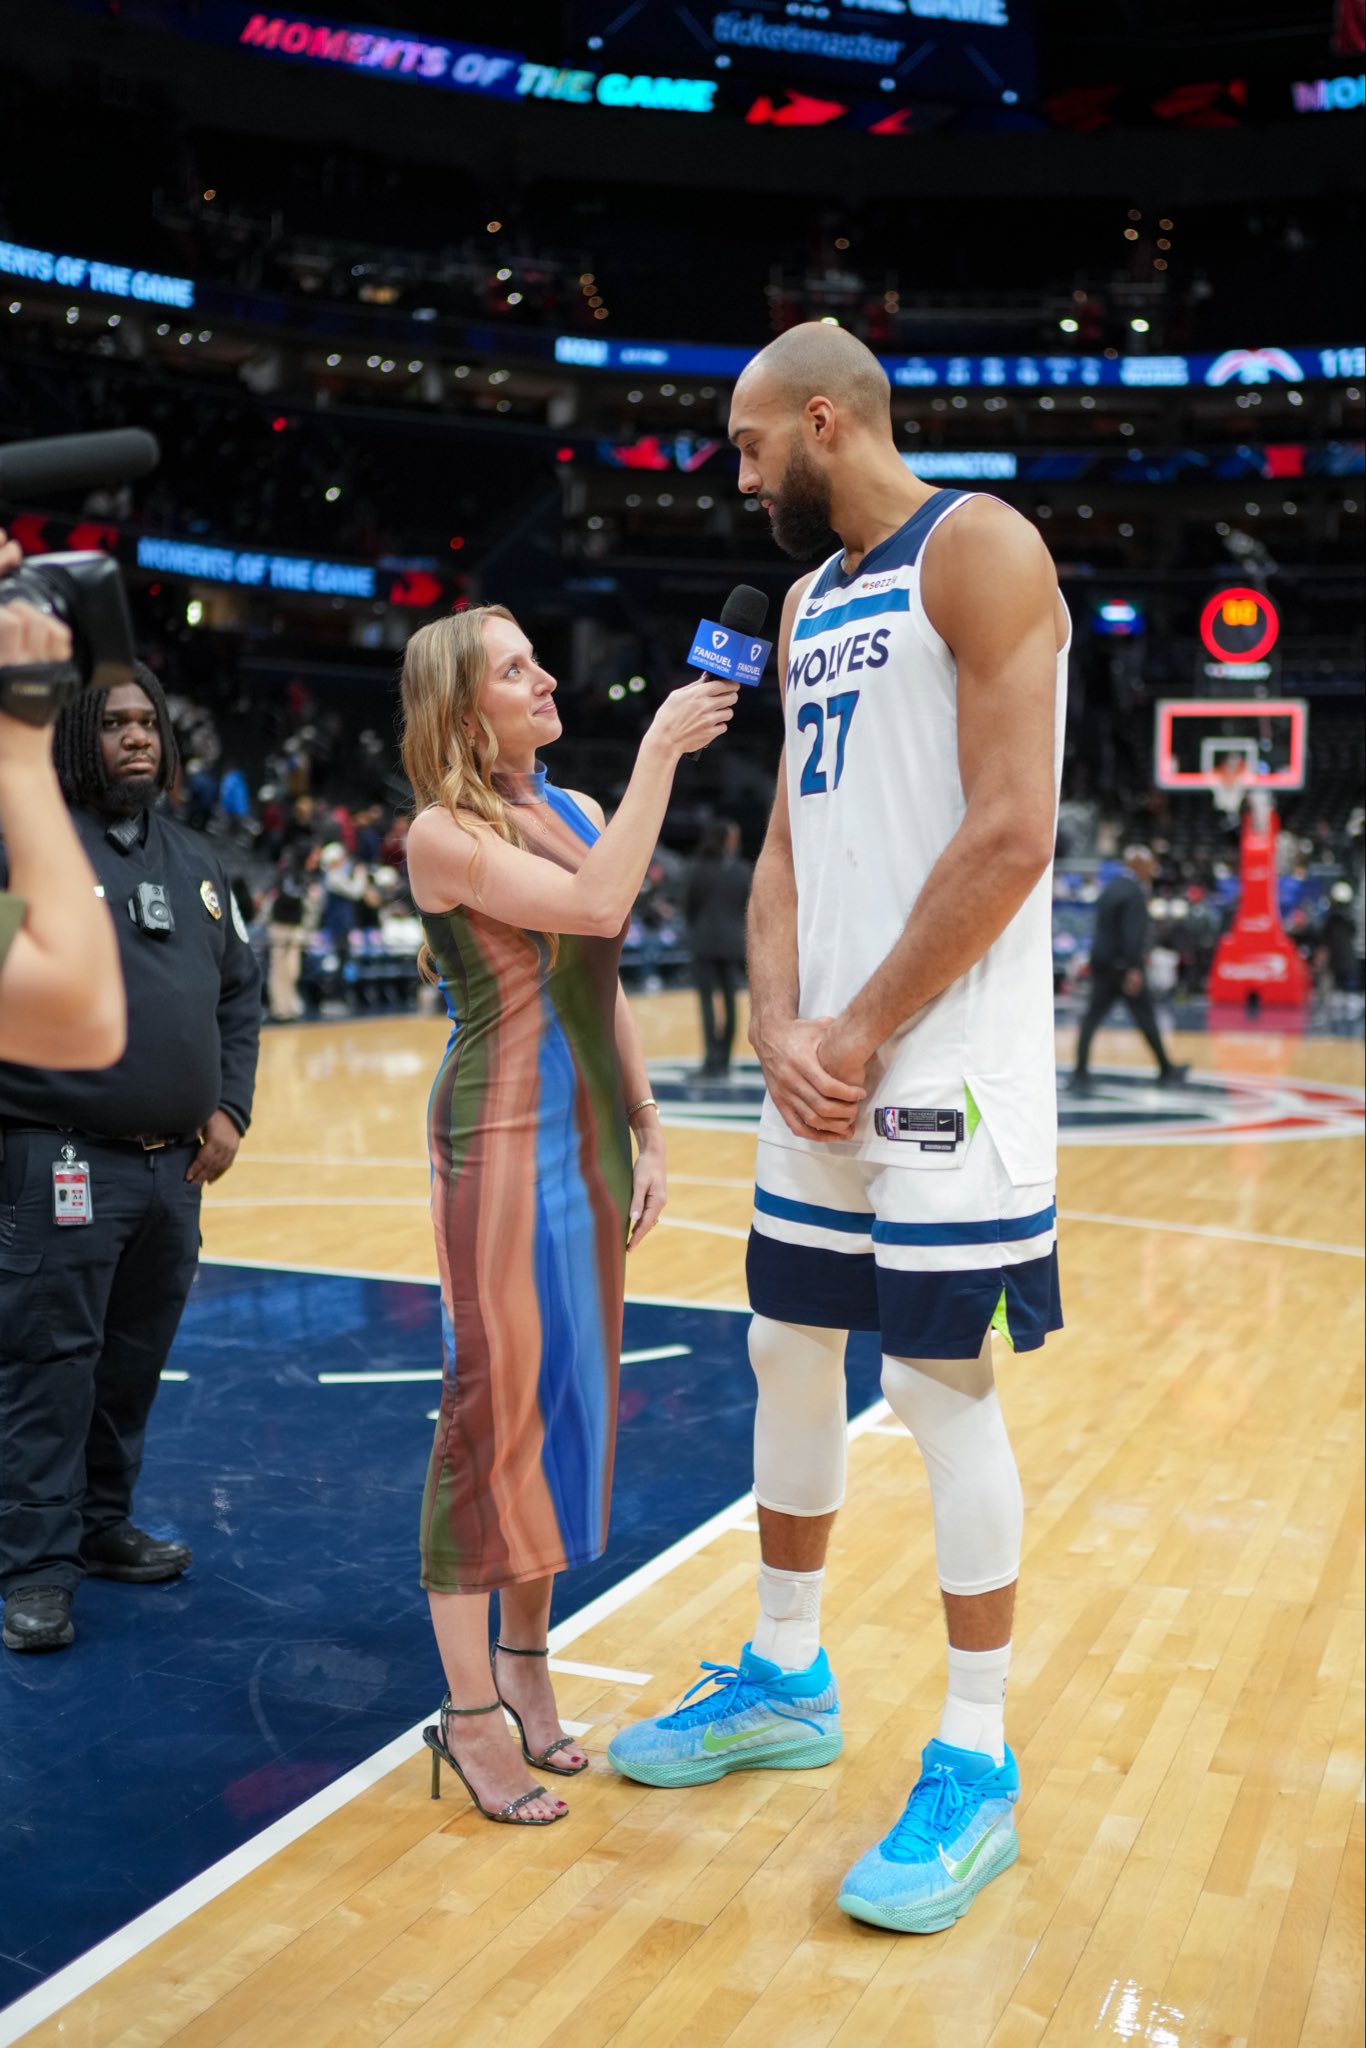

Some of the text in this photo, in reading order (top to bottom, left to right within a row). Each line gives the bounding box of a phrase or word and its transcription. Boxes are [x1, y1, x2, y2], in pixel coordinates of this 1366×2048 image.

[239, 13, 718, 113] MOMENTS OF THE GAME
[1291, 74, 1366, 113] MO
[55, 255, 88, 288] OF
[89, 261, 132, 298] THE
[131, 270, 195, 308] GAME
[137, 535, 376, 598] MOMENTS OF THE GAME
[694, 645, 732, 668] FANDUEL
[737, 662, 761, 676] FANDUEL
[787, 628, 891, 694] WOLVES
[797, 690, 860, 797] 27
